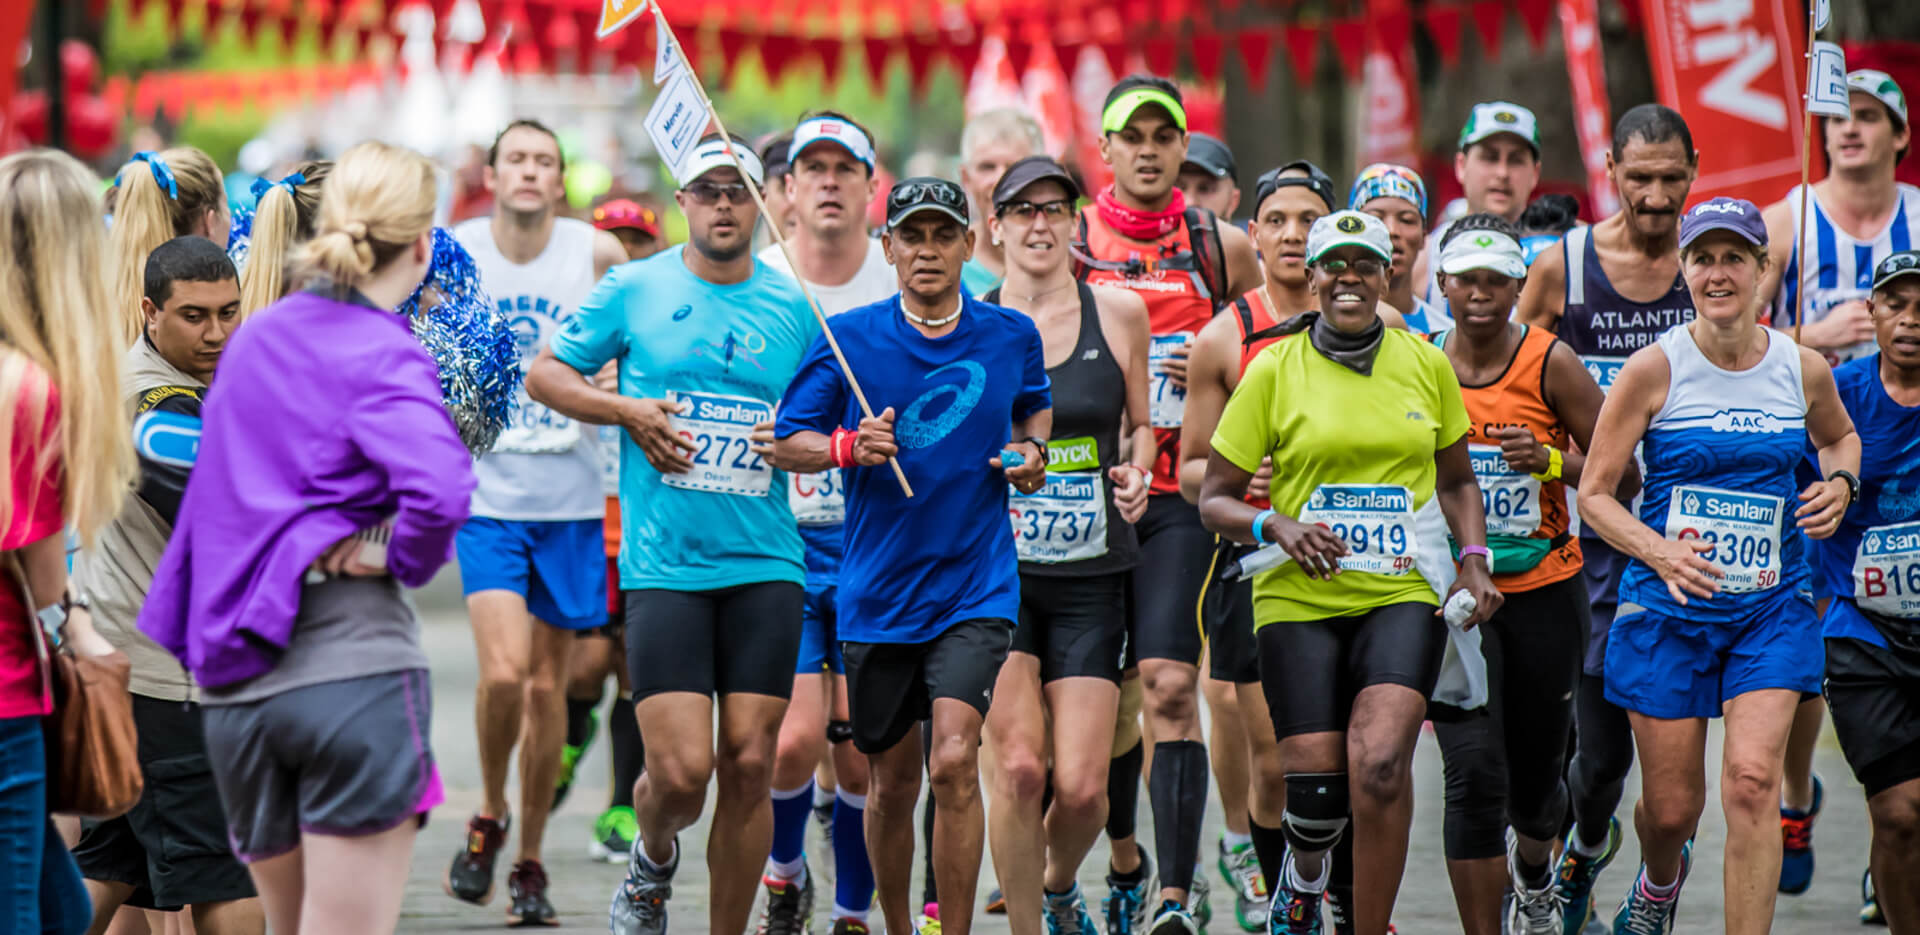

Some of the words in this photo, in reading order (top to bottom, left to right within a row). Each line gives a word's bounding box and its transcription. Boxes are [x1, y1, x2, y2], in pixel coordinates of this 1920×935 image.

[1591, 308, 1694, 329] ATLANTIS
[699, 401, 767, 423] Sanlam
[1731, 416, 1764, 428] AAC
[1049, 444, 1093, 465] DYCK
[795, 469, 844, 498] C3
[1039, 478, 1092, 497] anlam
[1332, 491, 1405, 509] Sanlam
[1706, 498, 1774, 523] Sanlam
[1315, 522, 1407, 556] 2919
[1393, 556, 1413, 570] 40
[1757, 569, 1776, 587] 50
[1864, 563, 1920, 598] B16
